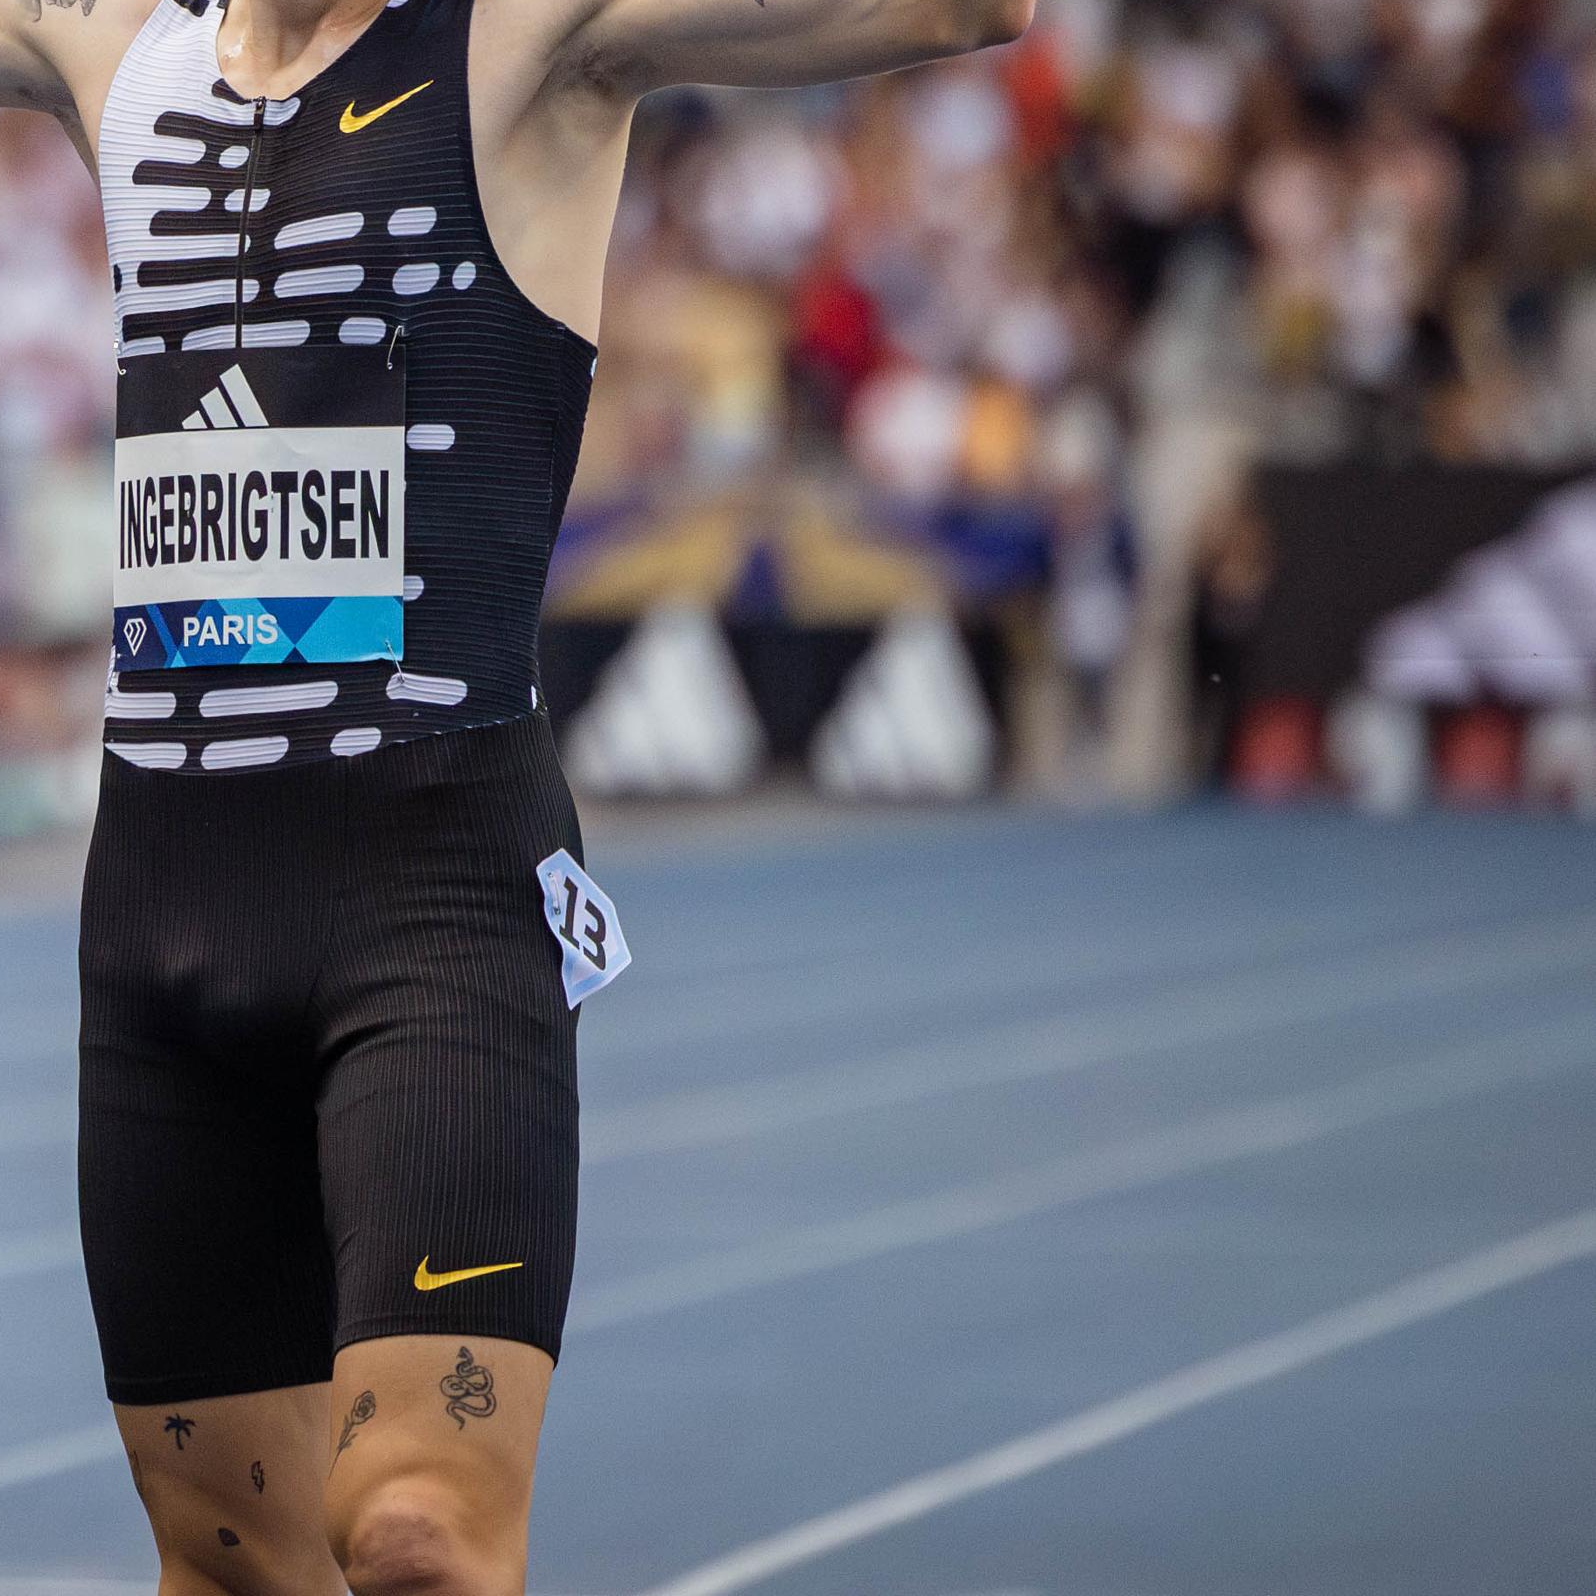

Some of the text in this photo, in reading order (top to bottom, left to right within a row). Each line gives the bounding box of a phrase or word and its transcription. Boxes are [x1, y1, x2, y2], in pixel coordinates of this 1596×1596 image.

[119, 469, 390, 570] INGEBRIGTSEN
[182, 613, 279, 648] PARIS
[558, 875, 607, 972] 13
